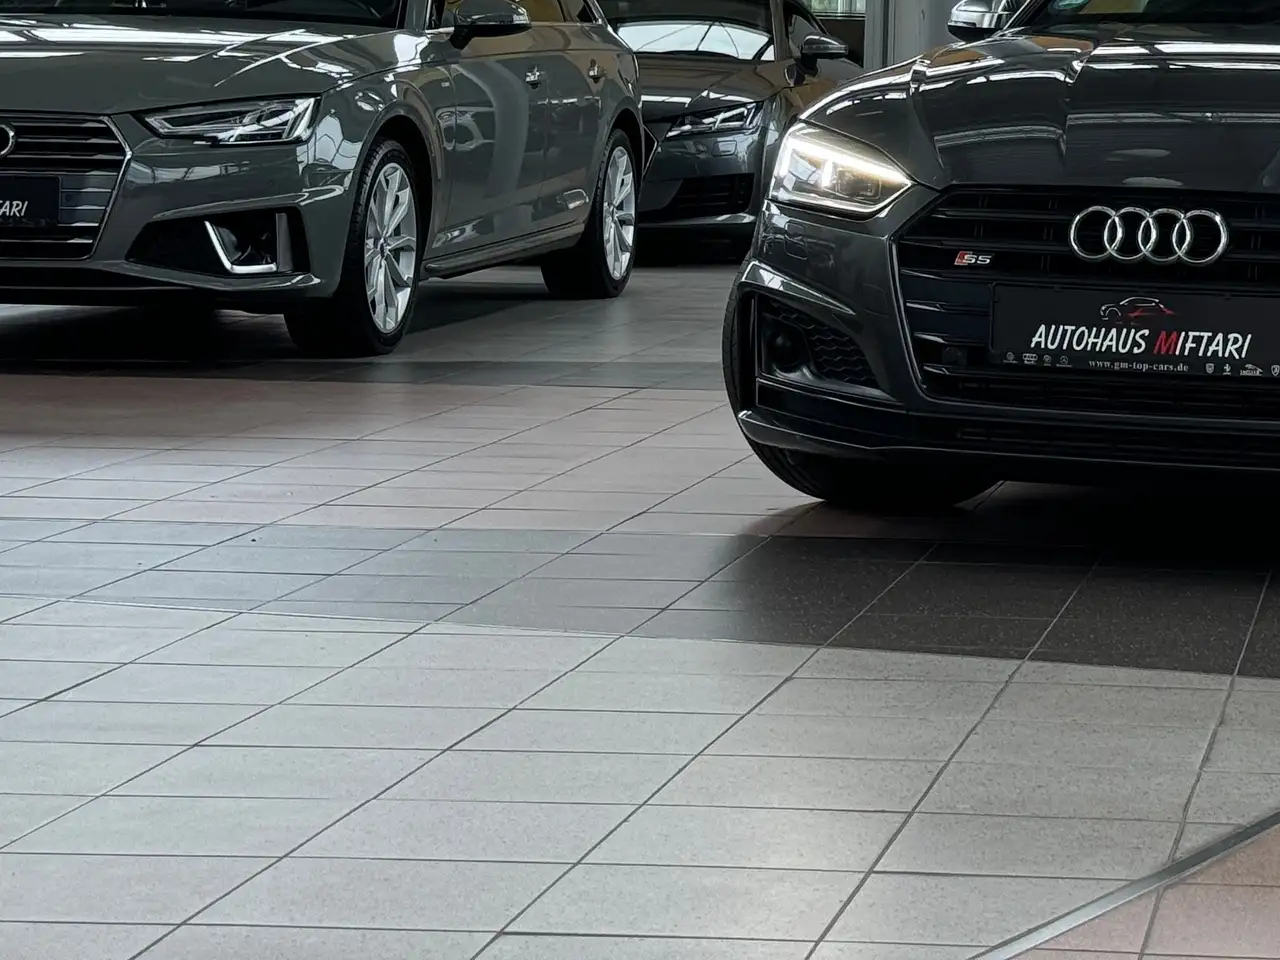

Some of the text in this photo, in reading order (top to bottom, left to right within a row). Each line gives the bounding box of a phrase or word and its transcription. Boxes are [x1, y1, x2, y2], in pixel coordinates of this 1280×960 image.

[961, 253, 992, 265] S5
[1030, 324, 1252, 360] AUTOHAUS MIFTARI
[1088, 360, 1189, 373] www.gm-top-cars.de
